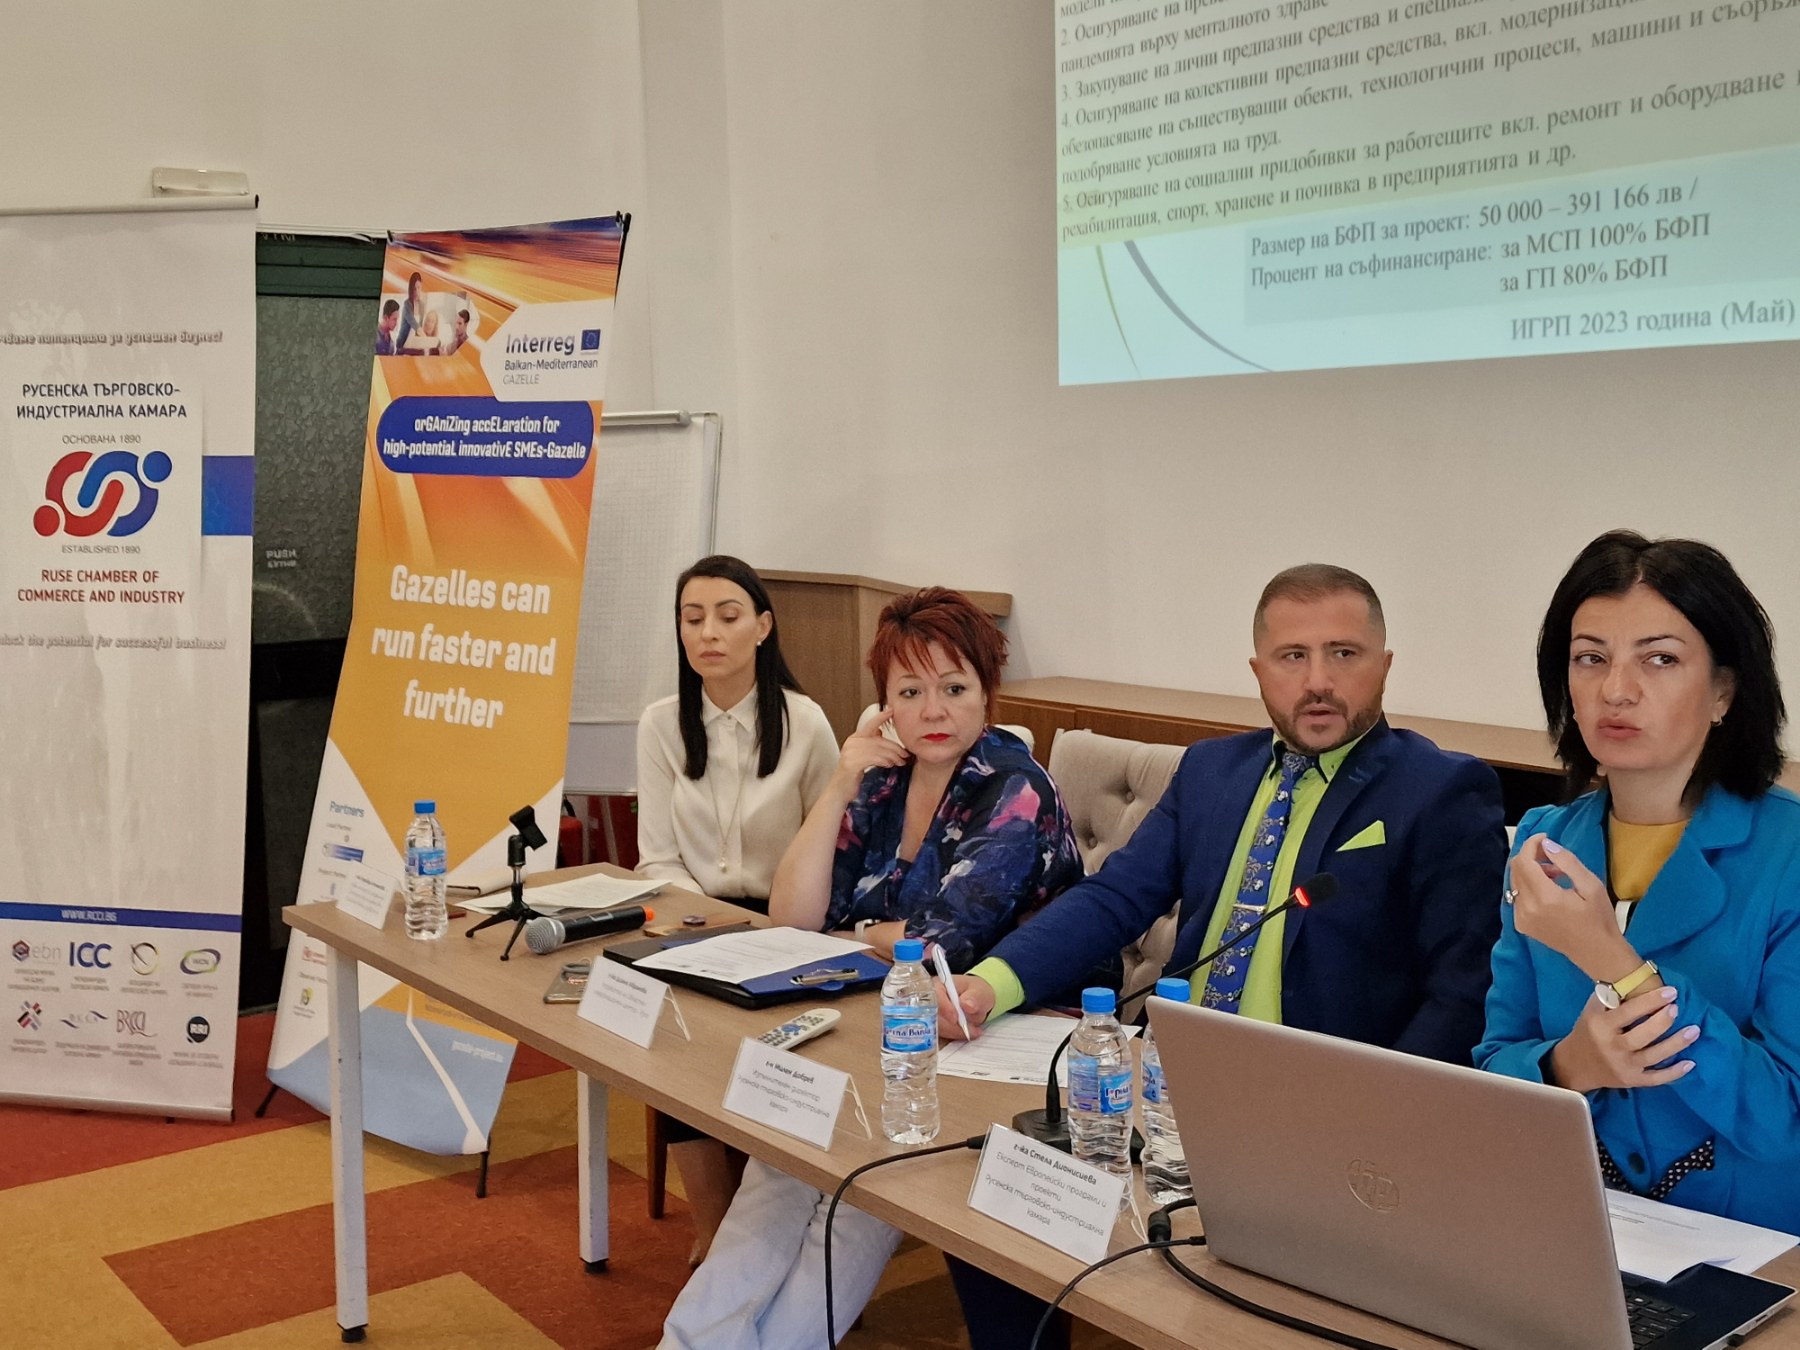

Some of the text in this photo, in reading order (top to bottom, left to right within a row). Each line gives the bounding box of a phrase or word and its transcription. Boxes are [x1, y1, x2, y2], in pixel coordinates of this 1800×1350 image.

[1060, 28, 1071, 46] 2.
[1075, 9, 1158, 42] Осигуряване
[1164, 3, 1180, 17] на
[1061, 44, 1134, 73] пандемията
[1140, 31, 1179, 53] върху
[1184, 8, 1270, 40] менталното
[1061, 84, 1072, 101] 3.
[1076, 69, 1148, 97] Закупуване
[1154, 64, 1169, 79] на
[1174, 51, 1217, 74] лични
[1223, 32, 1302, 66] предпазни
[1309, 12, 1379, 46] средства
[1388, 9, 1397, 23] и
[1062, 111, 1072, 128] 4.
[1076, 95, 1158, 127] Осигуряване
[1165, 91, 1180, 106] на
[1185, 71, 1268, 102] колективни
[1276, 49, 1359, 85] предпазни
[1366, 32, 1446, 66] средства,
[1455, 21, 1492, 42] вкл.
[1062, 126, 1152, 156] обезопасяване
[1159, 121, 1174, 136] на
[1179, 98, 1287, 132] съществуващи
[1294, 85, 1352, 109] обекти,
[1361, 56, 1484, 95] технологични
[1494, 36, 1581, 72] процеси,
[1591, 15, 1680, 48] машини
[1690, 9, 1703, 28] и
[1062, 129, 1281, 184] подобряване условията на труд.
[1063, 194, 1073, 211] 5.
[1077, 183, 1159, 208] Осигуряване
[1165, 177, 1180, 193] на
[1185, 165, 1253, 191] социални
[1260, 147, 1355, 178] придобивки
[1364, 144, 1380, 159] за
[1385, 123, 1492, 162] работещите
[1501, 117, 1539, 136] вкл.
[1547, 98, 1621, 133] ремонт
[1630, 96, 1643, 114] и
[1651, 70, 1785, 110] оборудване
[1062, 145, 1576, 241] рехабилитация, спорт, хранене и почивка в предприятията и др.
[1251, 235, 1305, 256] Размер
[1311, 232, 1329, 249] на
[1334, 221, 1376, 247] БФП
[1381, 223, 1398, 240] за
[1404, 213, 1470, 241] проект:
[1479, 204, 1501, 227] 50
[1507, 199, 1542, 222] 000
[1567, 190, 1601, 216] 391
[1613, 184, 1649, 210] 166
[1656, 184, 1682, 205] лв
[1251, 213, 1711, 290] Процент на съфинансиране: за МСП 100% БФП
[1500, 254, 1668, 292] за ГП 80% БФП
[1511, 299, 1795, 341] ИГРП 2023 година (Май)
[506, 334, 575, 355] Interreg
[503, 374, 540, 385] GAZELLE
[504, 359, 599, 371] Balkan-Mediterranean
[22, 383, 181, 397] РУСЕНСКА ТЪРГОВСКО-
[17, 404, 187, 420] ИНДУСТРИАЛНА КАМАРА
[414, 415, 560, 436] orGAniZing accELaration for
[62, 434, 141, 445] ОСНОВАНА 1890
[383, 438, 587, 460] high-potentiaL innovativE SMEs-Gazelle
[62, 544, 141, 555] ESTABLISHED 1890
[41, 569, 160, 583] RUSE CHAMBER OF
[390, 564, 551, 614] Gazelles can
[18, 589, 185, 604] COMMERCE AND INDUSTRY
[371, 623, 557, 676] run faster and
[403, 679, 504, 729] further
[329, 800, 365, 818] Partners
[32, 941, 113, 969] ebn ICC
[1029, 1149, 1053, 1167] Стела
